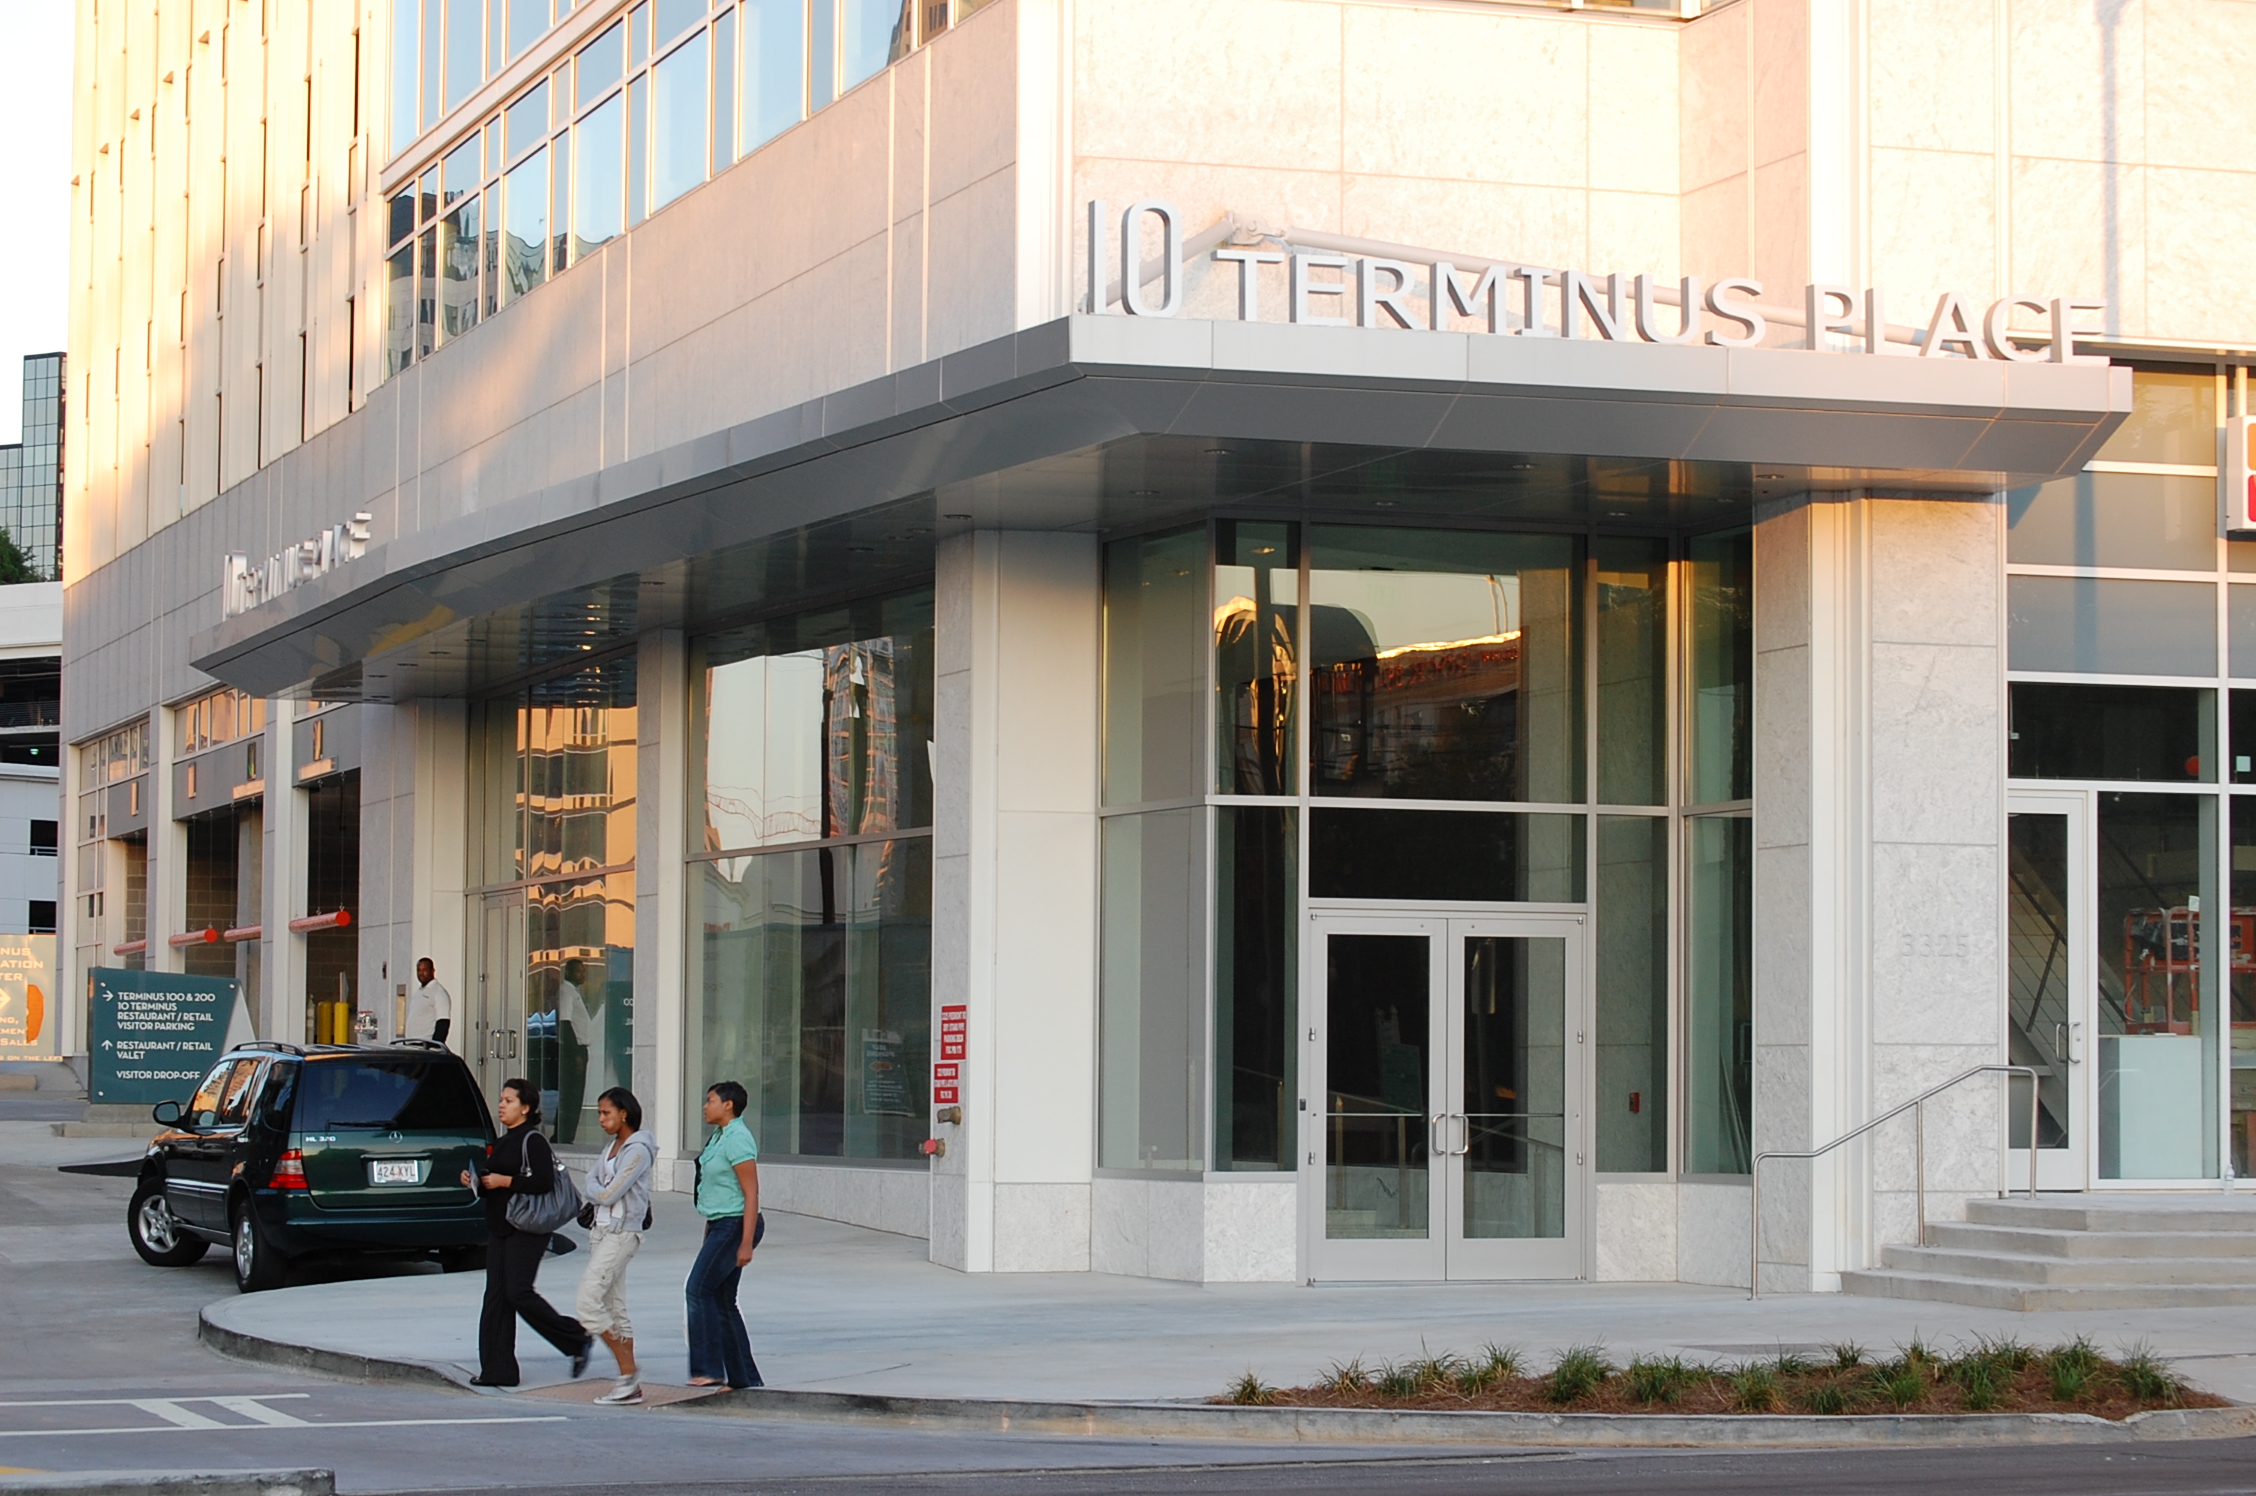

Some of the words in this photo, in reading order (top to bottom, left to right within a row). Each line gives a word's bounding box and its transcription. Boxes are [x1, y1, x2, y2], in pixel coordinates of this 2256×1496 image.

[1087, 199, 1182, 318] 10
[1210, 249, 1768, 348] TERMINUS
[1805, 283, 2111, 366] PLACE
[1901, 933, 1971, 958] 3325
[0, 947, 31, 956] NUS
[0, 960, 44, 969] ATION
[117, 992, 165, 1001] TERMINUS
[165, 993, 185, 1001] 100
[186, 993, 193, 1001] &
[194, 993, 216, 1002] 200
[117, 1002, 129, 1010] 10
[130, 1002, 177, 1011] TERMINUS
[117, 1012, 176, 1021] RESTAURANT
[182, 1013, 214, 1021] RETAIL
[117, 1022, 154, 1030] VISITOR
[154, 1022, 195, 1031] PARKING
[116, 1041, 176, 1050] RESTAURANT
[182, 1042, 213, 1051] RETAIL
[116, 1051, 145, 1060] VALET
[116, 1071, 152, 1079] VISITOR
[153, 1071, 201, 1080] DROP-OFF
